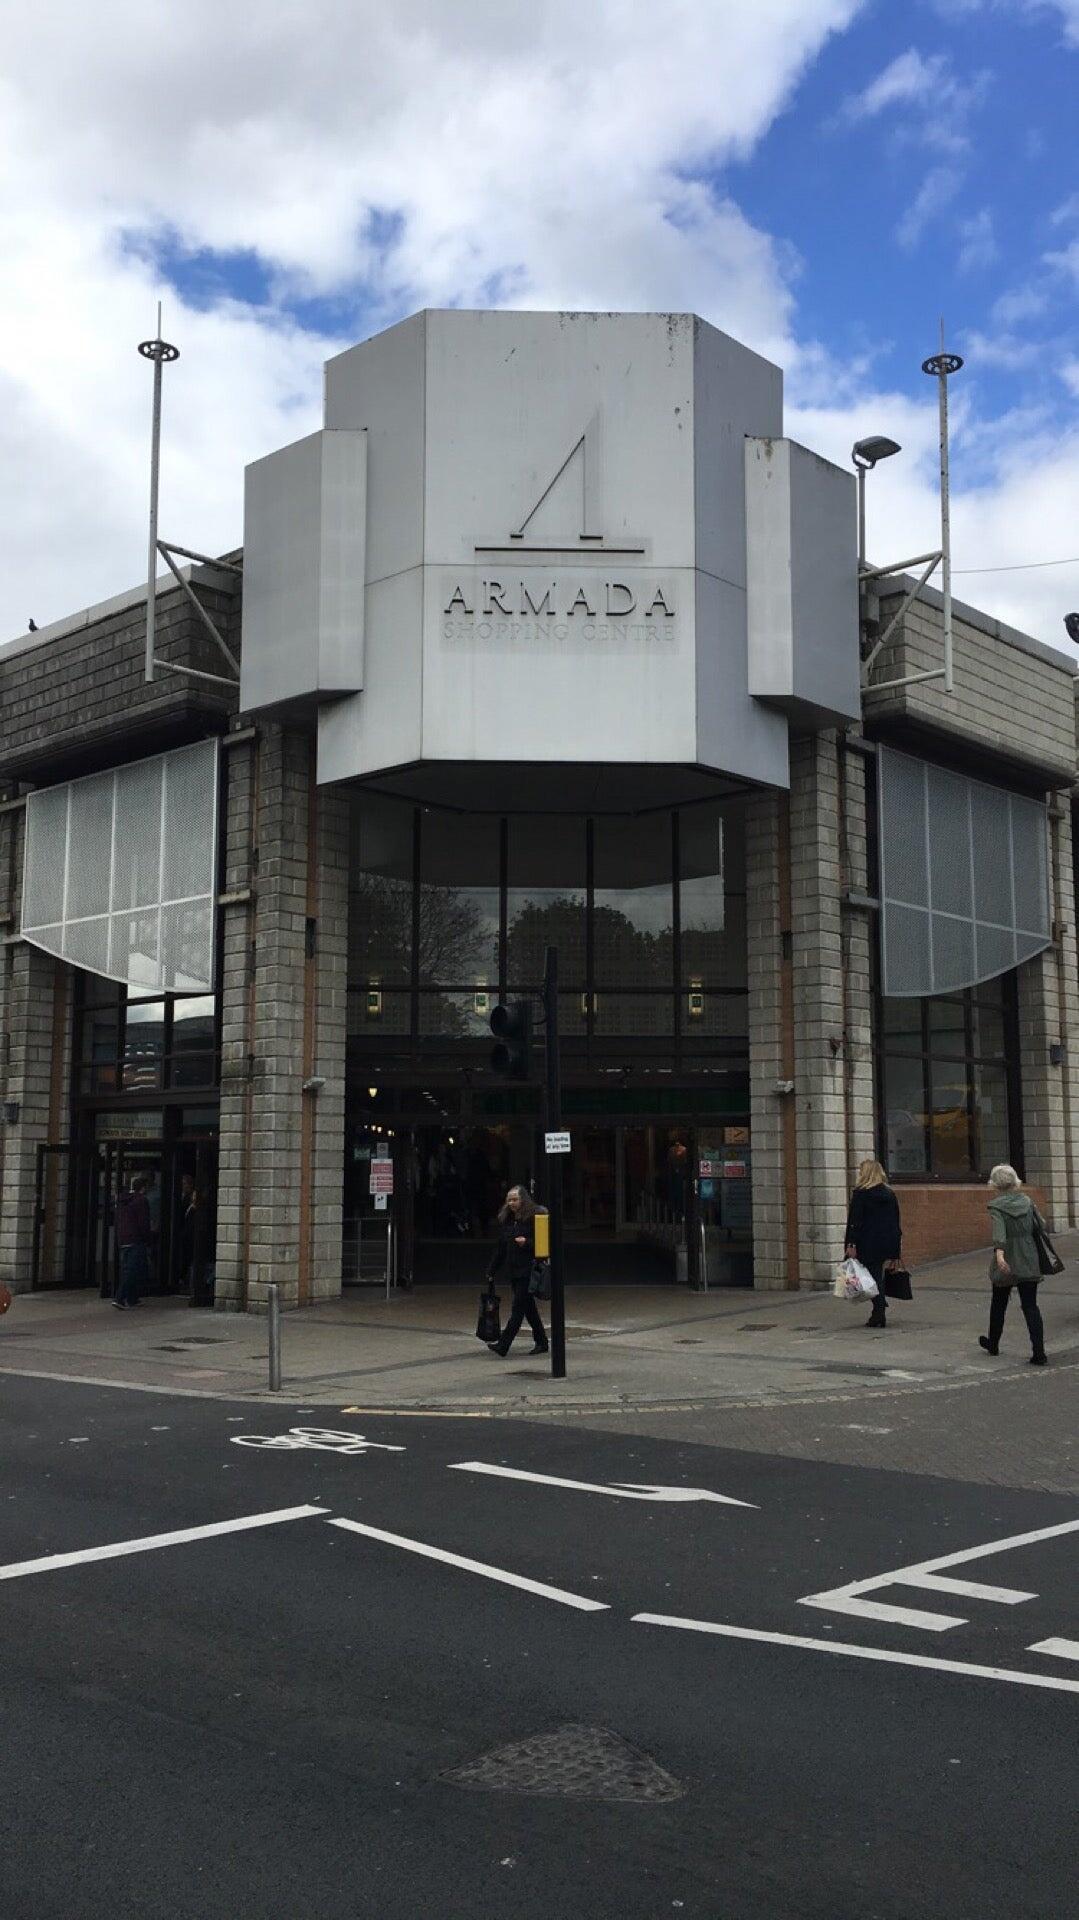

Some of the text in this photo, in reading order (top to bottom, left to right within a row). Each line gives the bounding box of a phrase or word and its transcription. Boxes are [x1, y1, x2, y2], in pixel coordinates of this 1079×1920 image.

[444, 581, 675, 617] ARMADA
[443, 621, 675, 642] SHOPPING CENTRE
